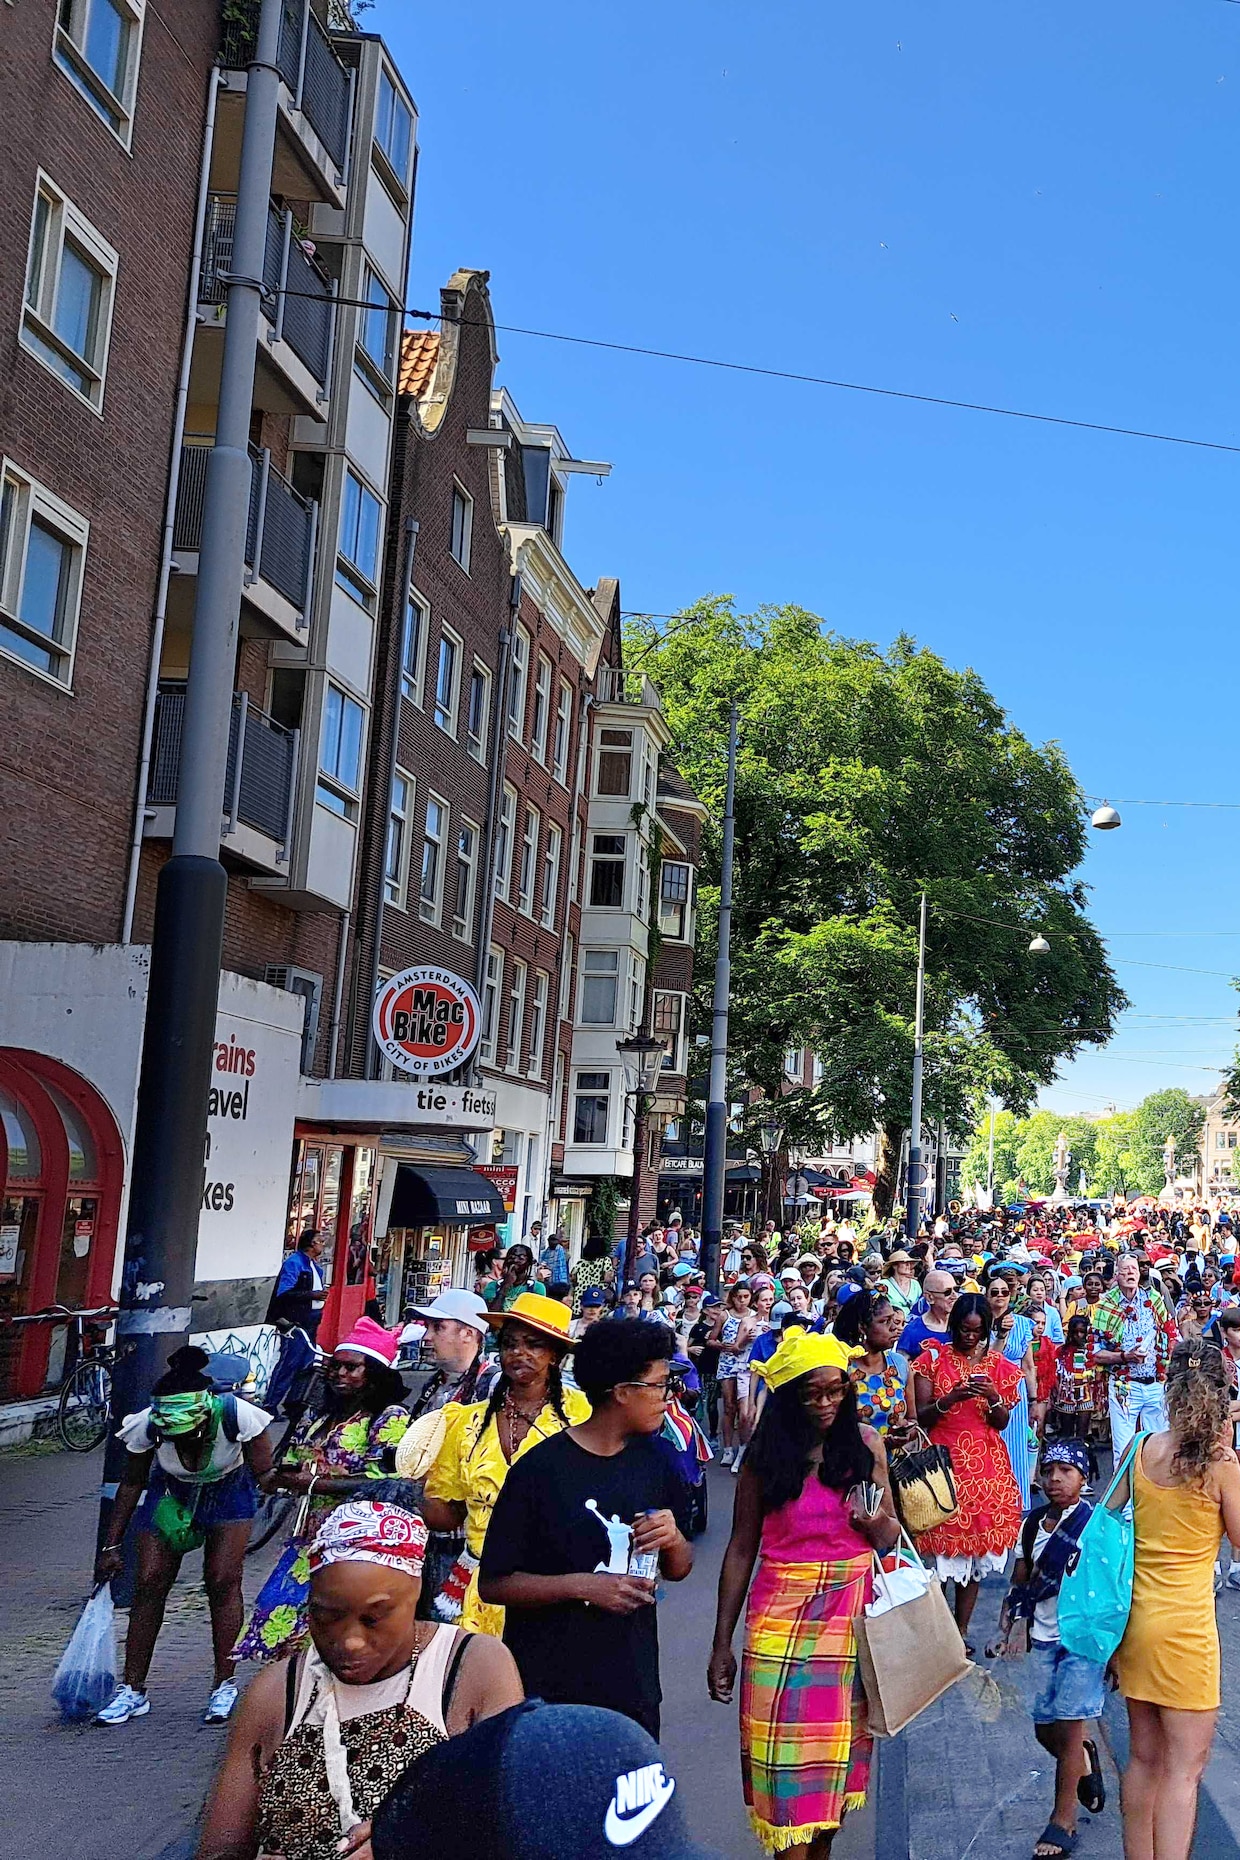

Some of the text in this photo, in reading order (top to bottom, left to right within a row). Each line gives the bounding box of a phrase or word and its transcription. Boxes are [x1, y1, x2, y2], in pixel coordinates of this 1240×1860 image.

[397, 971, 465, 997] AMSTERDAM
[413, 989, 464, 1023] Mac
[393, 1011, 447, 1046] Bike
[386, 1042, 464, 1071] CITY OF BIKES
[417, 1087, 447, 1111] tie
[616, 1763, 668, 1814] NIKE
